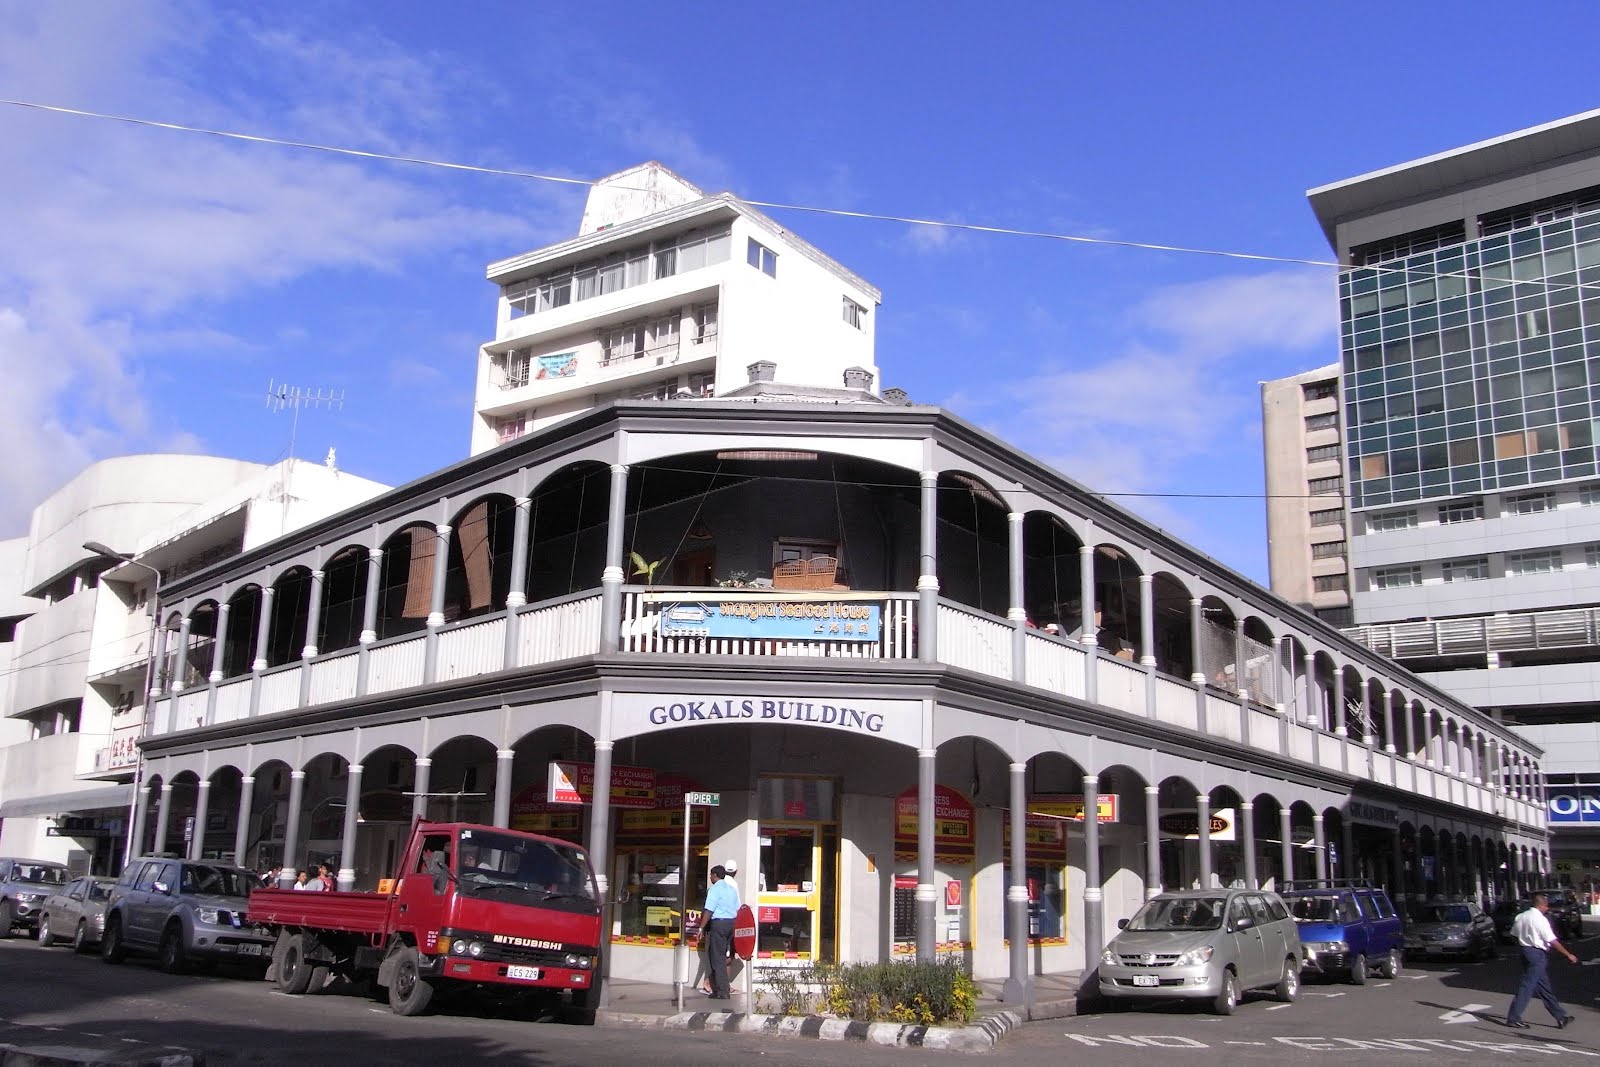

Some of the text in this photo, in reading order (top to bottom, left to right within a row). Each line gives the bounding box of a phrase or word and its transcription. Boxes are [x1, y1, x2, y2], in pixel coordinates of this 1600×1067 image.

[719, 602, 870, 622] Shanghai Seafood House
[649, 699, 884, 732] GOKALS BUILDING
[619, 770, 654, 780] EXCHANGE
[656, 784, 682, 796] PRESS
[694, 793, 711, 804] PIER
[936, 806, 970, 818] EXCHANGE
[493, 934, 562, 950] MITSUBISHI
[513, 968, 538, 978] CS 229
